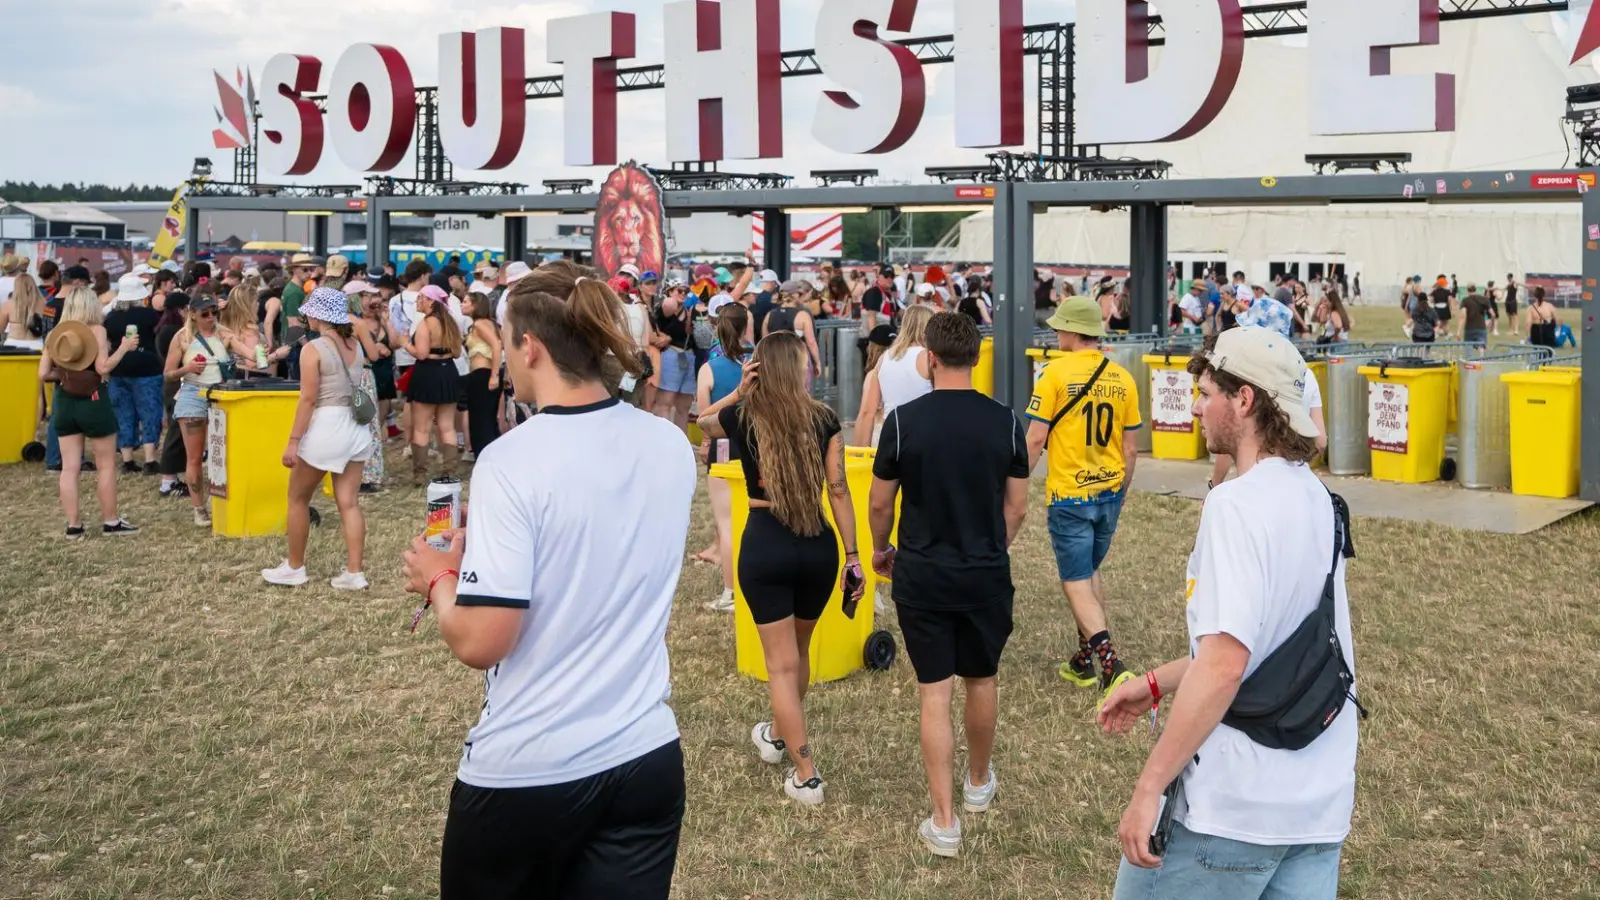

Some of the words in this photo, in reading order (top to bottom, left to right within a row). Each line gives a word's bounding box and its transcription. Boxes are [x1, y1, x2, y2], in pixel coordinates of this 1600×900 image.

[257, 0, 1455, 176] SOUTHSIDE
[1537, 176, 1573, 185] ZEPPELIN
[1157, 387, 1187, 397] SPENDE
[1163, 395, 1182, 404] DEIN
[1160, 402, 1186, 412] PFAND
[1374, 402, 1403, 413] SPENDE
[1379, 411, 1397, 420] DEIN
[1082, 400, 1114, 448] 10
[1376, 419, 1401, 430] PFAND
